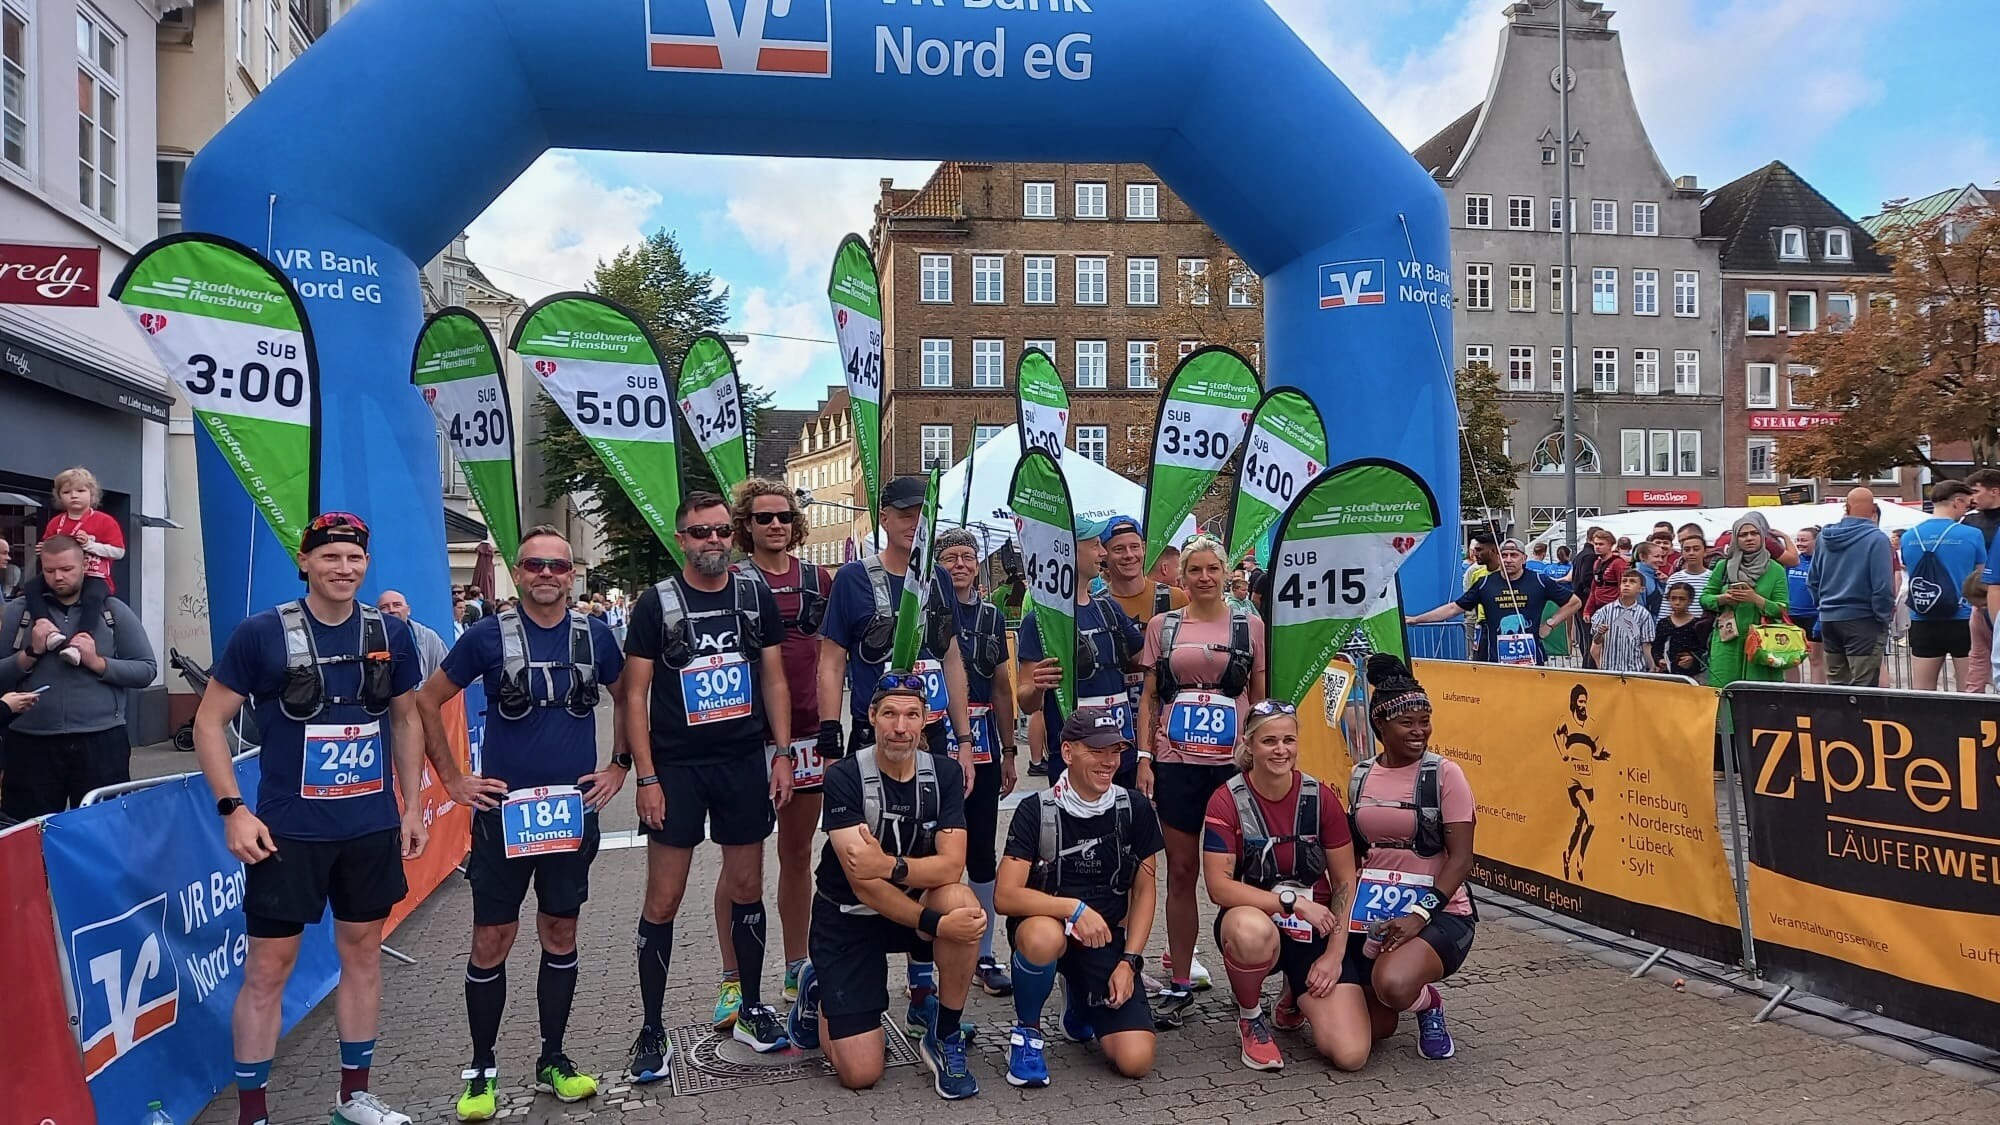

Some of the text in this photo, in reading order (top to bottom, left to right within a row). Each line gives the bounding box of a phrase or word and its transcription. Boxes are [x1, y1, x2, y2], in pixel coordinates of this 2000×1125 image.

[875, 25, 1093, 80] Nord eG
[275, 249, 380, 277] VR Bank
[1397, 261, 1450, 286] VR Bank
[188, 291, 264, 315] flensburg
[191, 279, 284, 305] stadtwerke
[352, 285, 382, 304] eG
[1399, 285, 1438, 305] Nord
[570, 338, 628, 354] flensburg
[572, 330, 643, 344] stadtwerke
[6, 347, 31, 375] tredy
[256, 340, 297, 360] SUB
[185, 353, 304, 408] 3:00
[847, 346, 881, 390] 4:45
[477, 387, 497, 403] SUB
[626, 375, 659, 390] SUB
[717, 384, 733, 400] SUB
[1208, 380, 1256, 395] stadtwerke
[1207, 388, 1247, 403] flensburg
[575, 390, 667, 429] 5:00
[696, 398, 737, 442] 3:45
[1167, 409, 1191, 423] SUB
[1753, 416, 1797, 428] STEAK
[449, 408, 505, 448] 4:30
[1162, 425, 1229, 460] 3:30
[1252, 433, 1270, 454] SUB
[208, 416, 286, 524] glasfaser ist grün
[1246, 452, 1294, 501] 4:00
[595, 441, 666, 528] glasfaser ist grün
[1341, 512, 1405, 525] flensburg
[1344, 501, 1422, 514] stadtwerke
[1053, 539, 1071, 556] SUB
[1284, 551, 1318, 567] SUB
[1027, 552, 1074, 600] 4:30
[1278, 568, 1366, 609] 4:15
[1319, 646, 1332, 661] ist
[1508, 641, 1525, 654] 53
[695, 666, 742, 698] 309
[698, 693, 745, 711] Michael
[1182, 706, 1225, 733] 128
[1184, 733, 1218, 745] Linda
[320, 740, 375, 770] 246
[1573, 763, 1590, 772] 1982
[334, 771, 360, 785] Ole
[1627, 767, 1651, 785] Kiel
[519, 799, 571, 829] 184
[1628, 790, 1689, 819] Flensburg
[517, 829, 574, 843] Thomas
[1629, 812, 1704, 842] Norderstedt
[1629, 833, 1675, 858] Lübeck
[1629, 857, 1656, 876] Sylt
[1365, 884, 1418, 914] 292
[1470, 862, 1583, 913] ufen ist unser Leben!
[179, 880, 208, 936] VR
[1769, 911, 1889, 953] Veranstaltungsservice
[187, 929, 230, 1003] Nord
